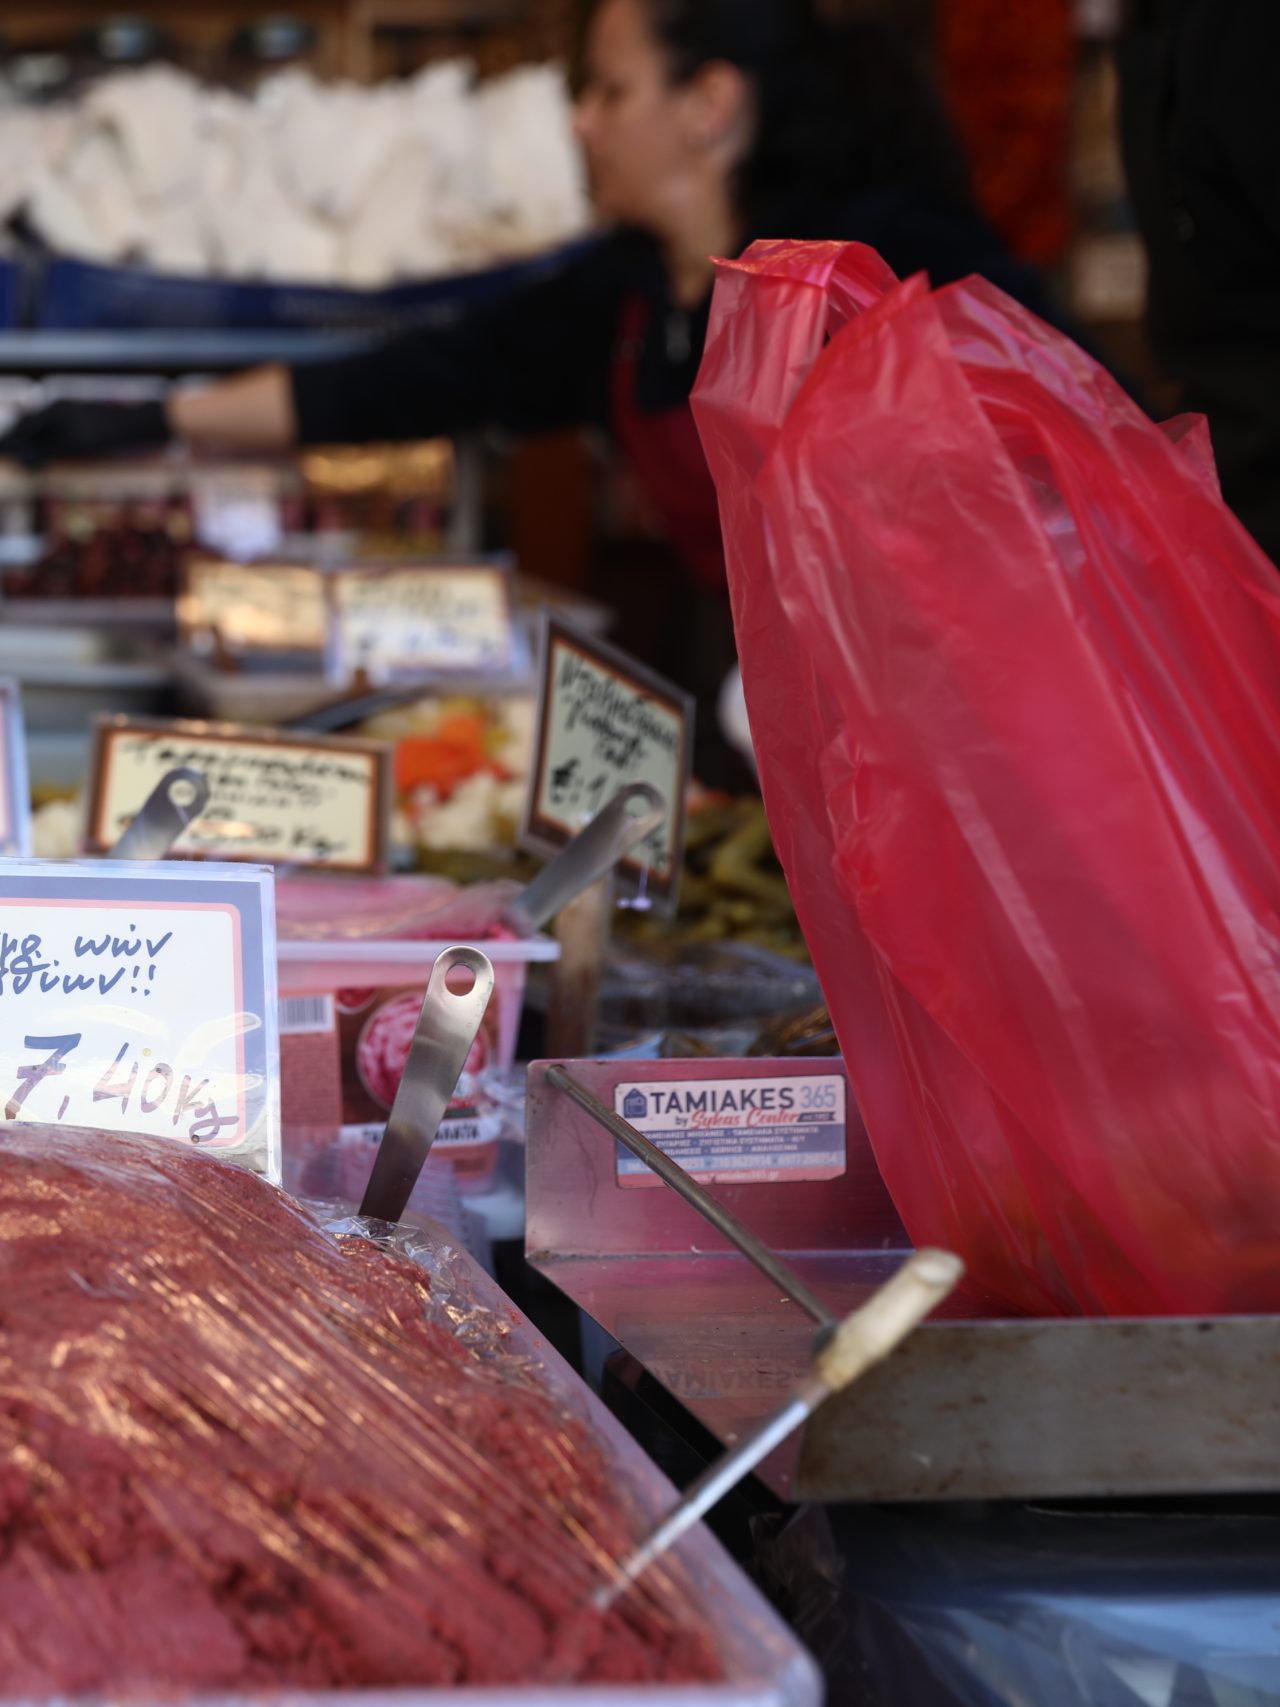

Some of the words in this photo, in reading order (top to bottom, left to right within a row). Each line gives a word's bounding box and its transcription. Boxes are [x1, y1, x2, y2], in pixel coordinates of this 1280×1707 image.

[650, 1087, 794, 1114] TAMIAKES
[800, 1084, 836, 1109] 365
[676, 1115, 689, 1127] by
[747, 1107, 798, 1128] Center
